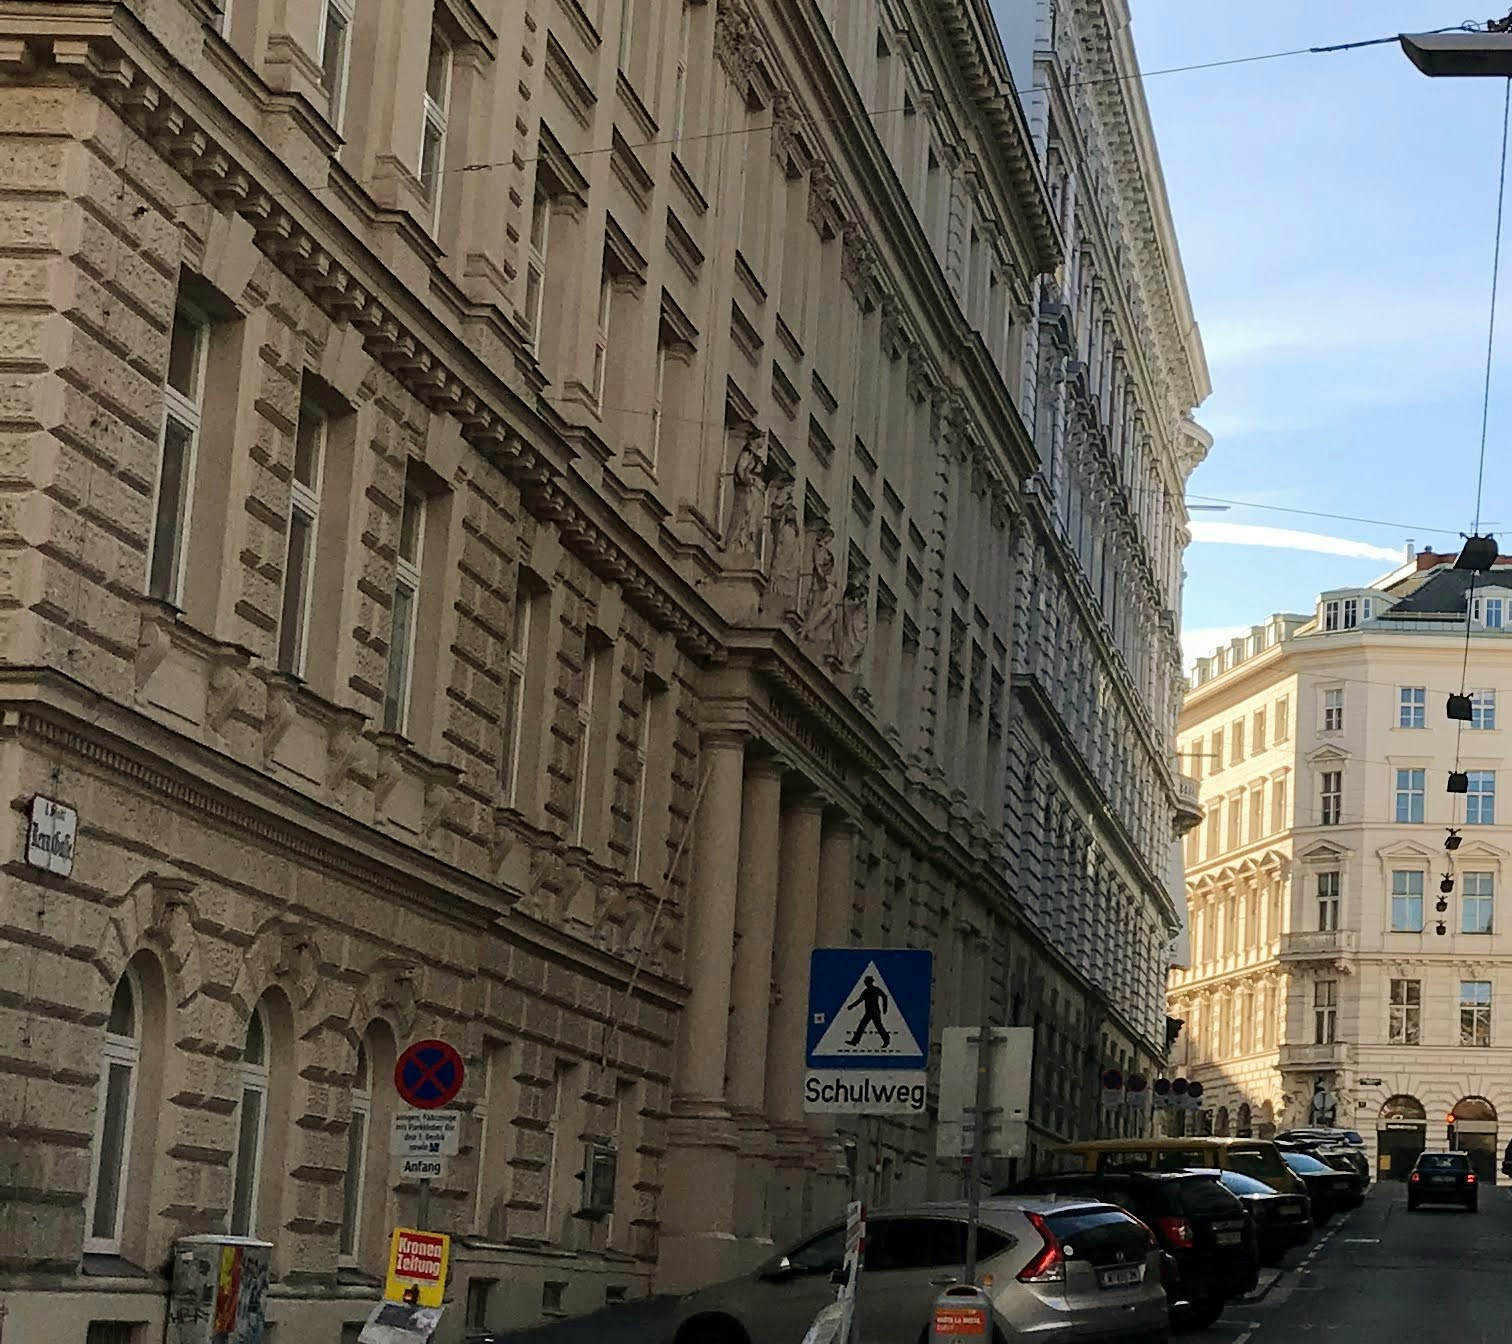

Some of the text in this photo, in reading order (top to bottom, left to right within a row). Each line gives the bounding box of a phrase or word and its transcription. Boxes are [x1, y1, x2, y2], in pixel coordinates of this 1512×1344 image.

[805, 1078, 924, 1109] Schulweg
[404, 1161, 440, 1175] Anfang
[398, 1237, 442, 1258] Kronen
[397, 1254, 440, 1276] Zeitung
